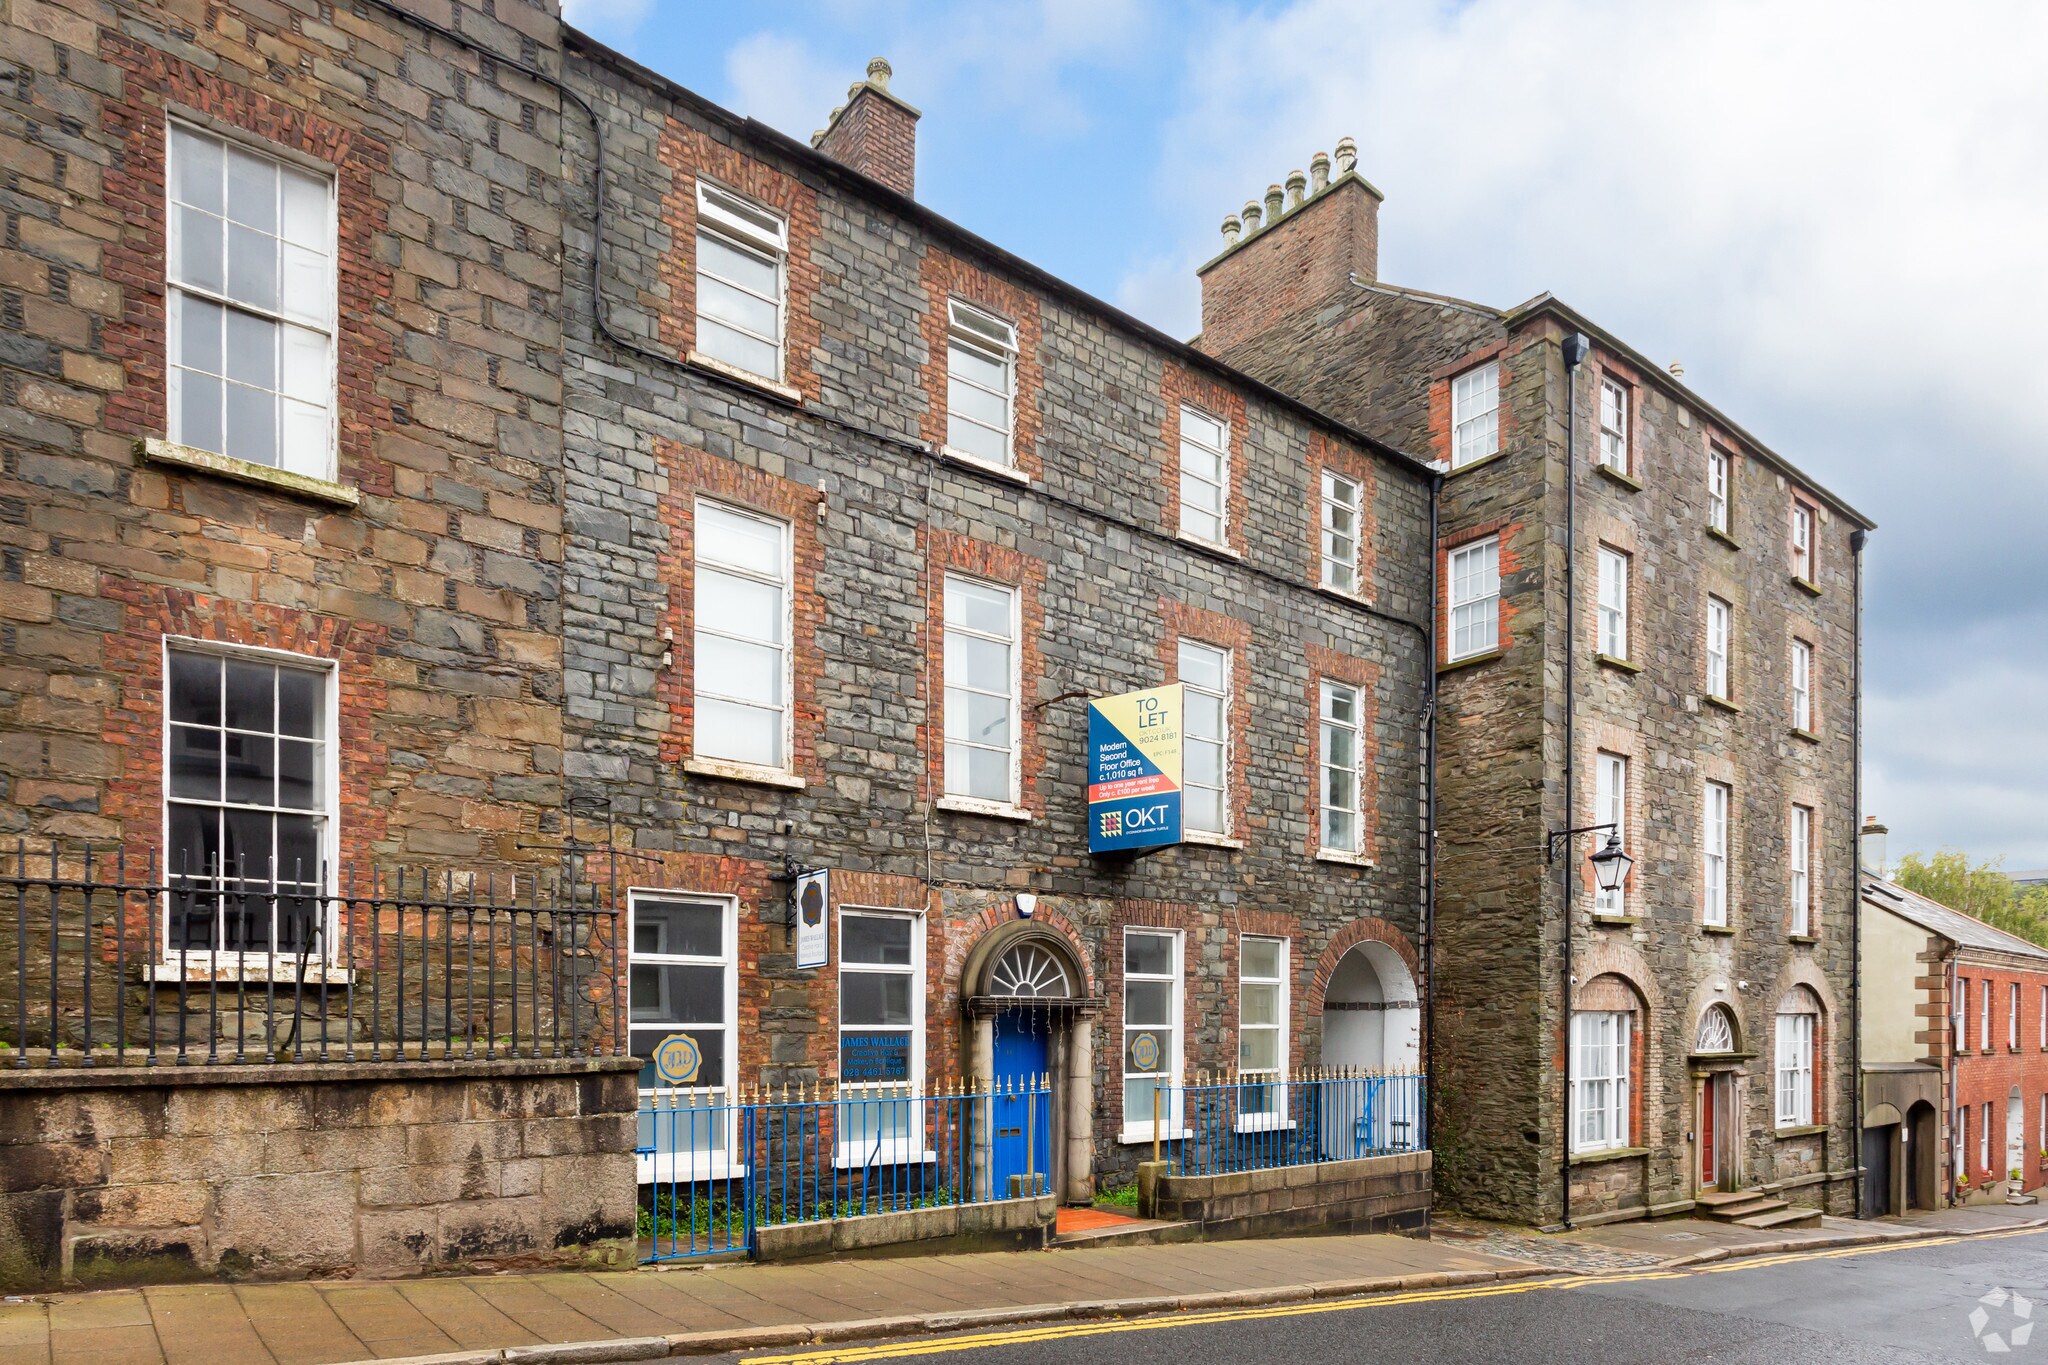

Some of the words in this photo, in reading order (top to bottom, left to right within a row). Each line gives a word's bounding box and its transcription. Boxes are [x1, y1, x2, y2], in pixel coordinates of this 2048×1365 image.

[1136, 698, 1158, 712] TO
[1139, 711, 1168, 728] LET
[1139, 735, 1158, 744] 9024
[1161, 732, 1177, 740] 8181
[1100, 742, 1127, 752] Modern
[1100, 750, 1127, 762] Second
[1100, 763, 1118, 772] Floor
[1120, 759, 1140, 768] Office
[1138, 766, 1143, 774] ft
[1126, 804, 1168, 828] OKT
[842, 1037, 868, 1049] JAMES
[870, 1036, 908, 1047] WALLACE
[844, 1068, 860, 1077] 028
[862, 1068, 882, 1076] 4461
[886, 1066, 906, 1076] 5767
